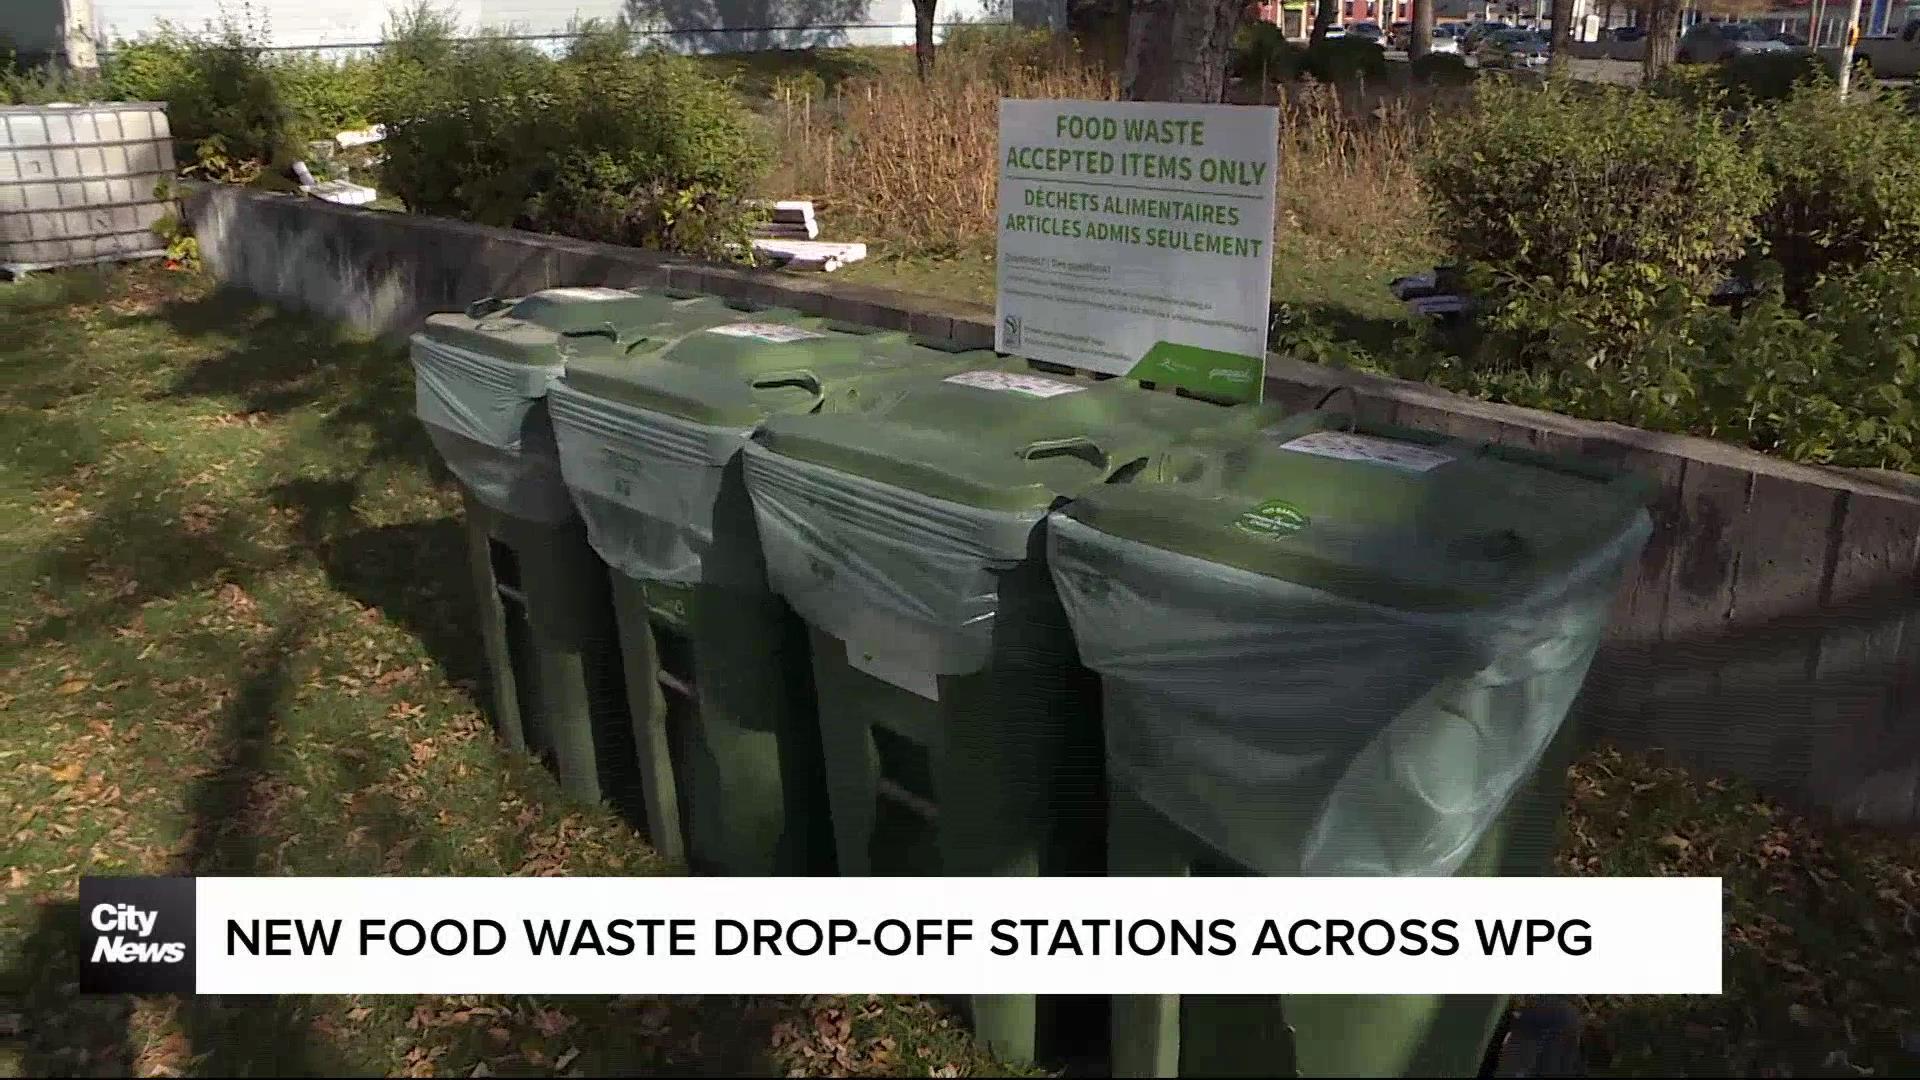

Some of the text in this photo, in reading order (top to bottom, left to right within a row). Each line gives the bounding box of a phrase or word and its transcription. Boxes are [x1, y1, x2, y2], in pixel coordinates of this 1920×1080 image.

[1056, 115, 1204, 146] FOOD WASTE
[1006, 147, 1266, 186] ACCEPTED ITEMS ONLY
[1024, 186, 1239, 226] DÉCHETS ALIMENTAIRES
[1006, 214, 1262, 257] ARTICLES ADMIS SEULEMENT
